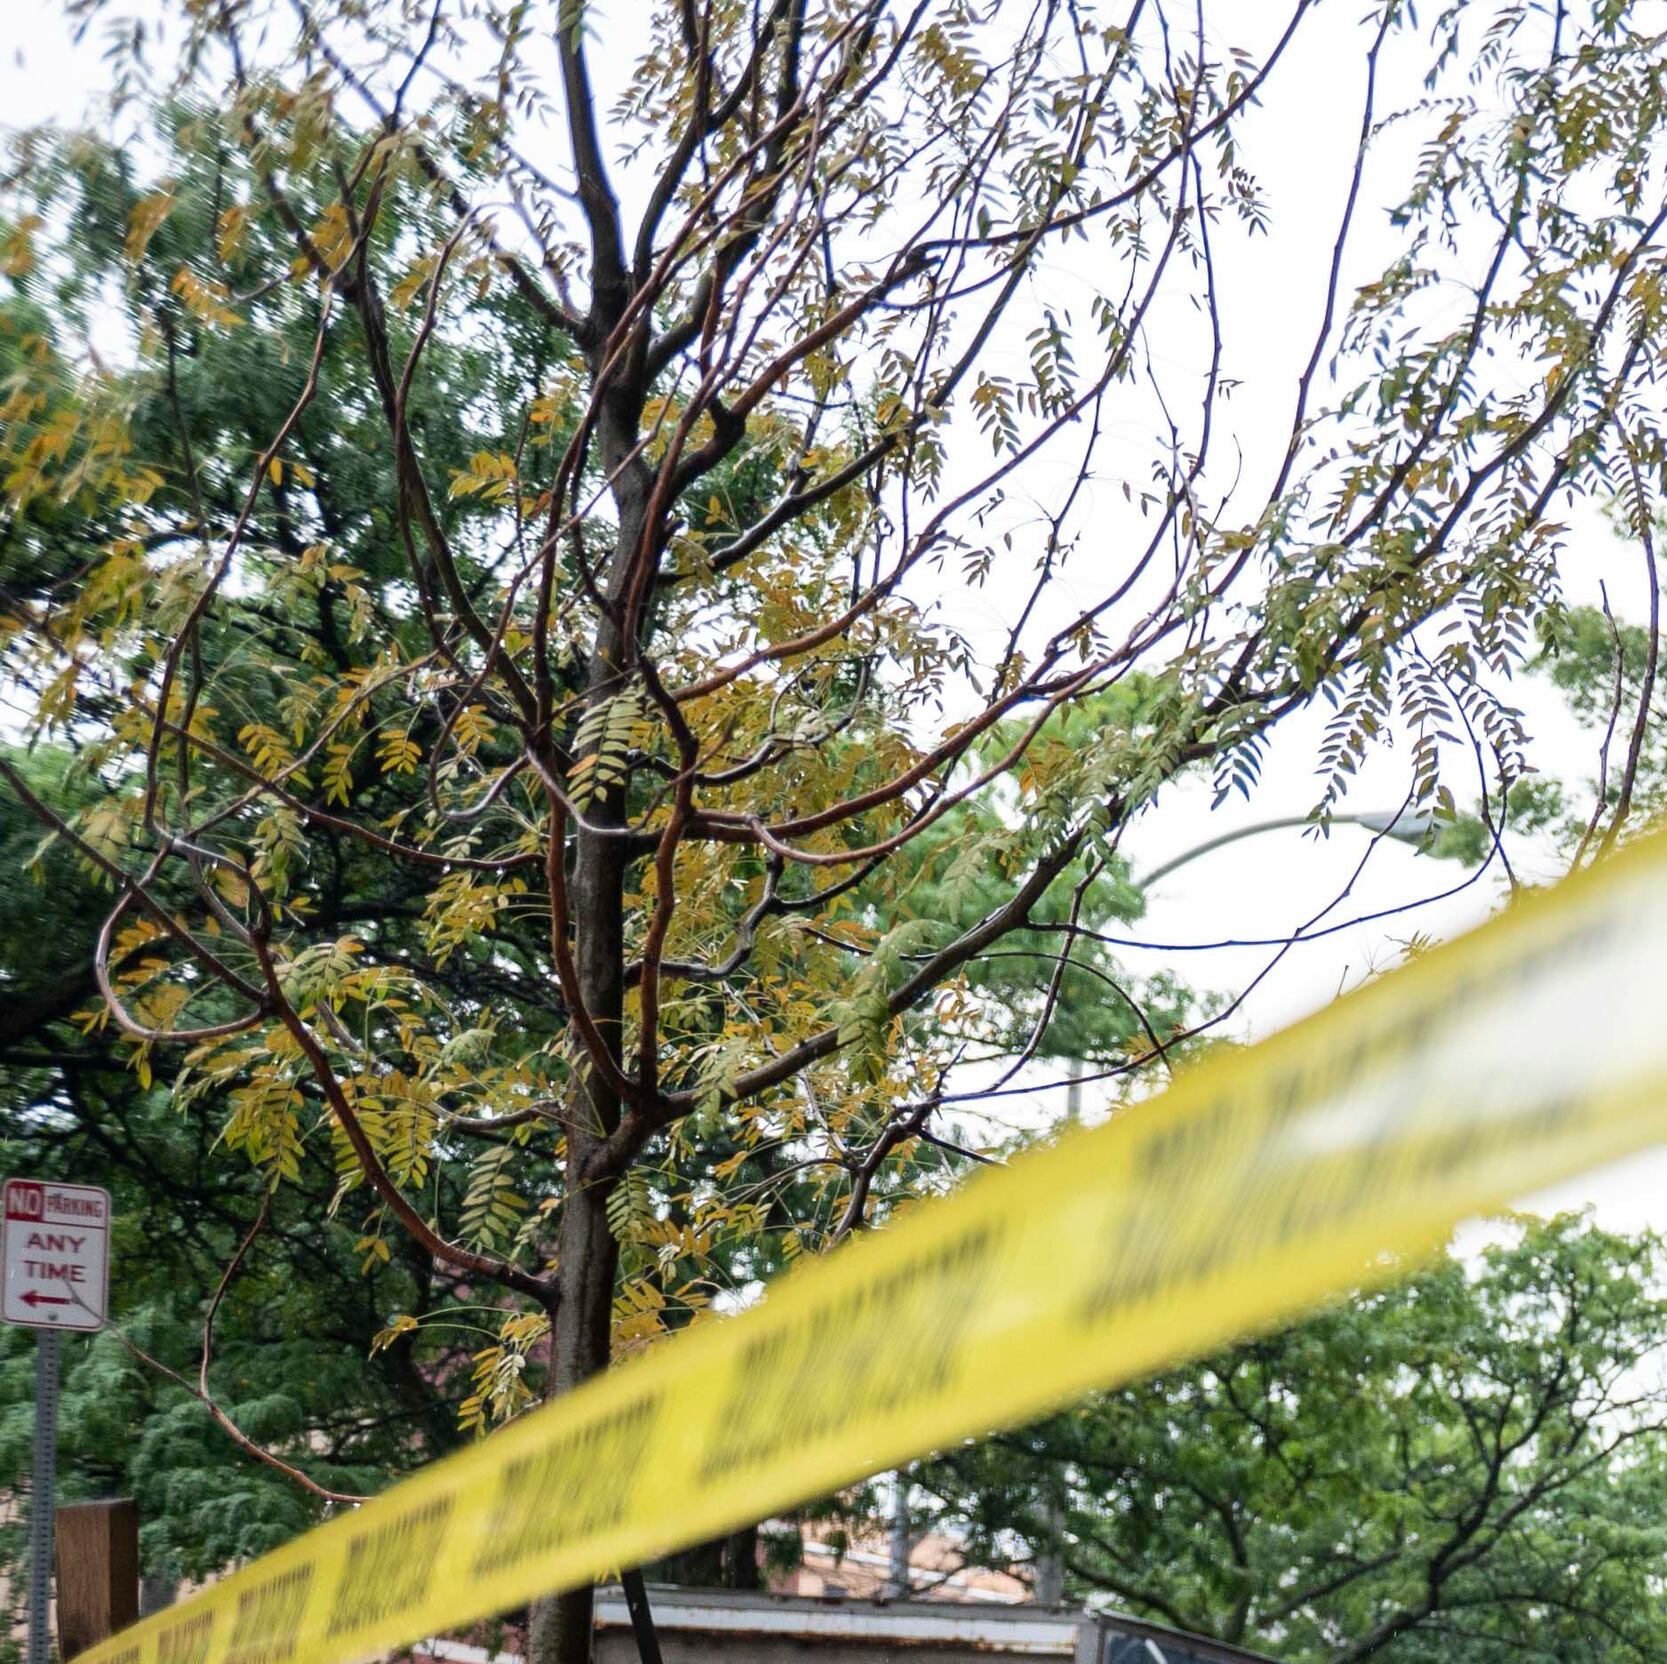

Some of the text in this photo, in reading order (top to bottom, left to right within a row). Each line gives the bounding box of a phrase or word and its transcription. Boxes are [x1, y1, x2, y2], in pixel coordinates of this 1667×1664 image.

[8, 1187, 102, 1218] NO PARKING
[27, 1232, 86, 1253] ANY
[23, 1260, 87, 1283] TIME
